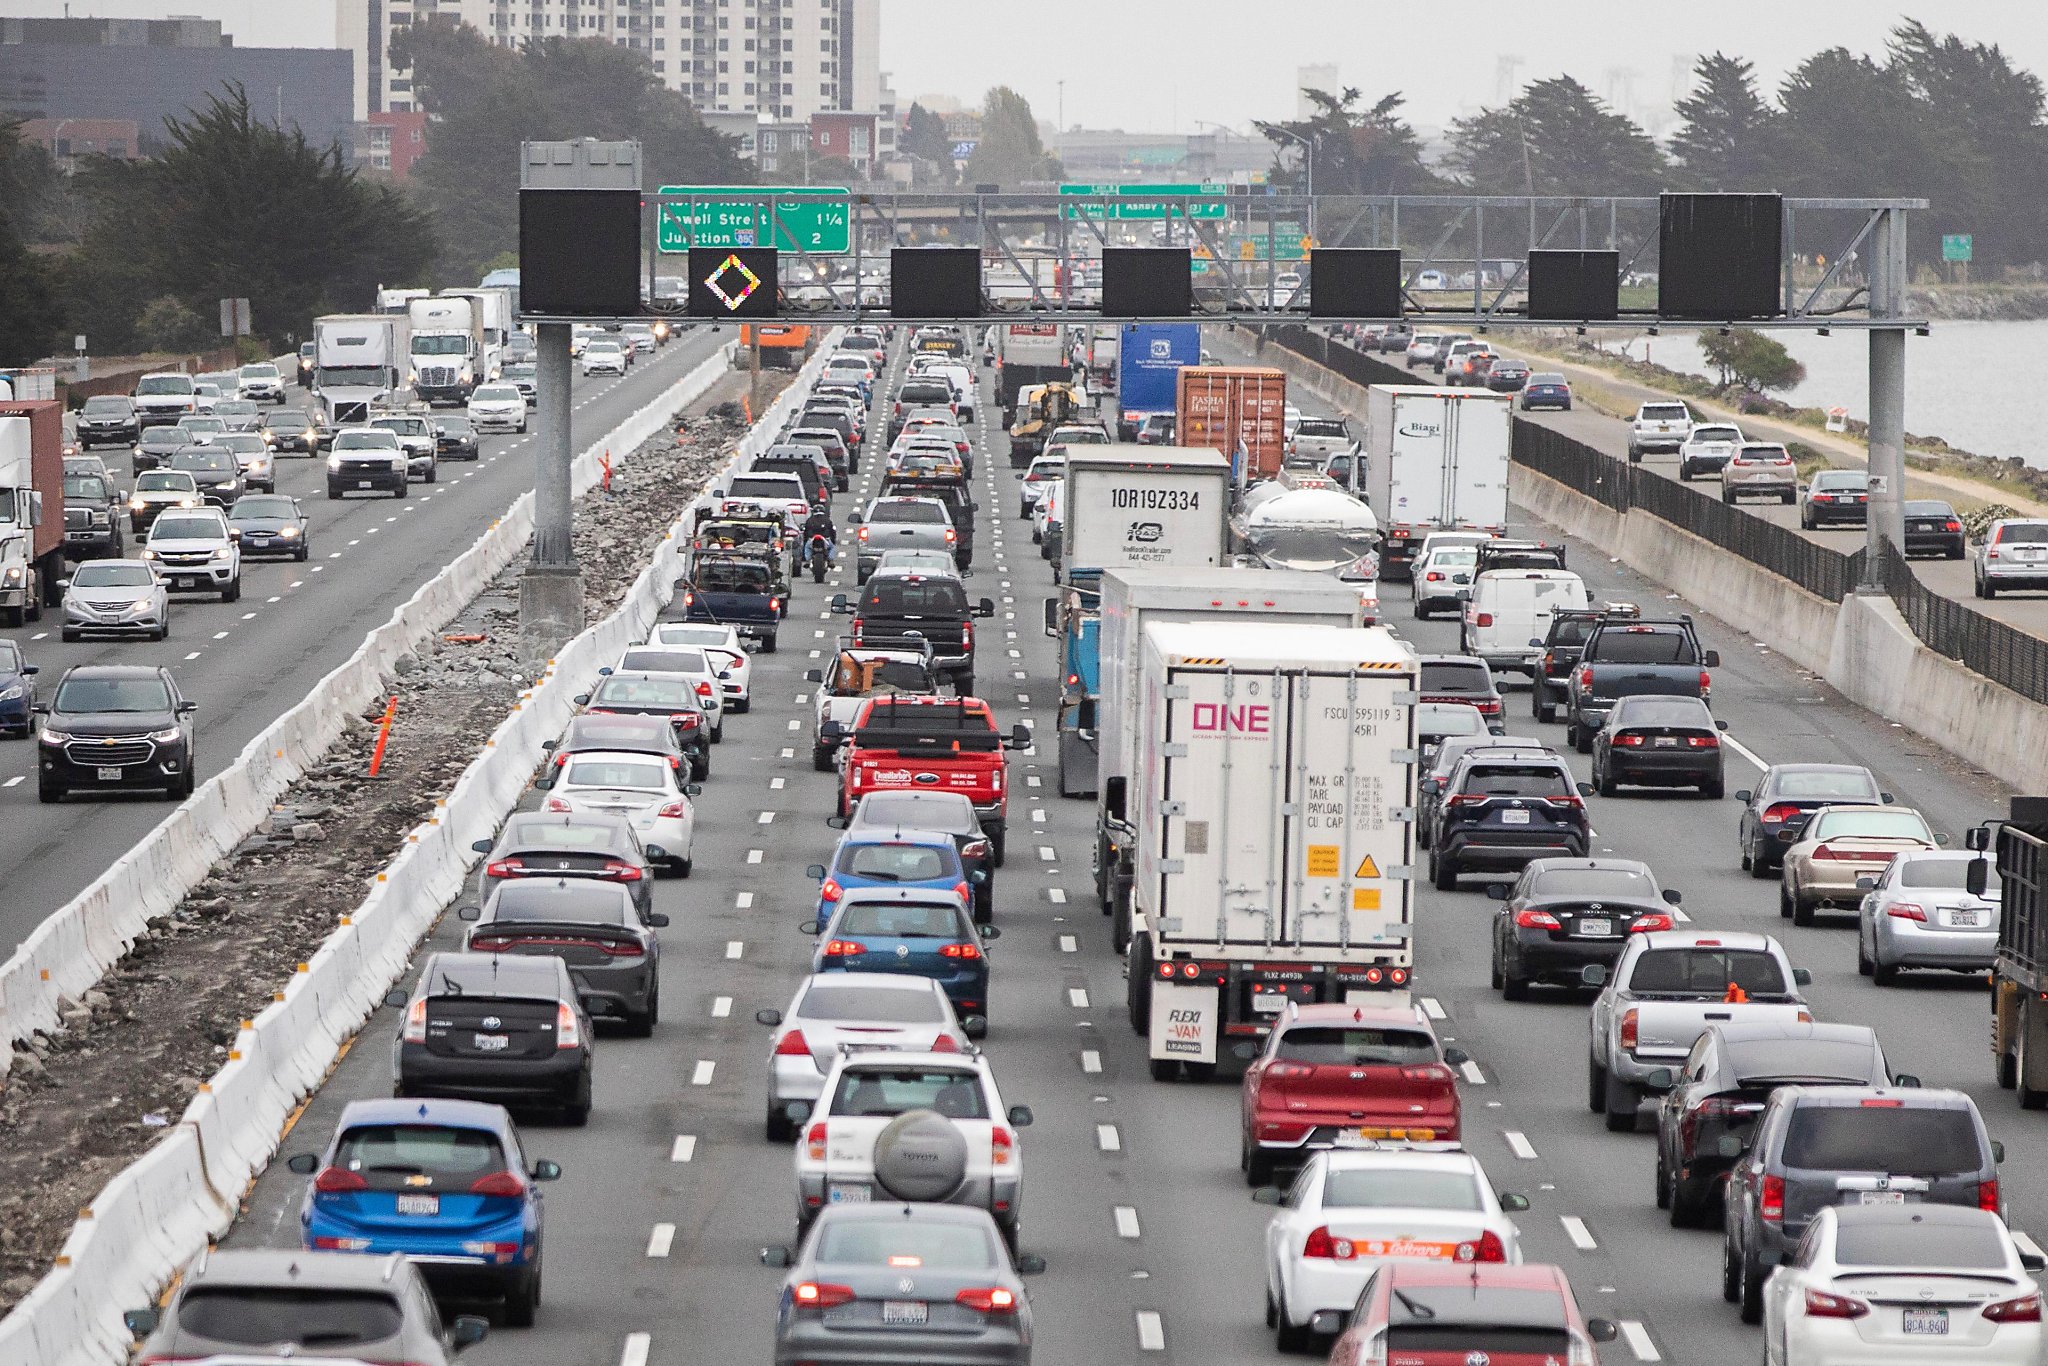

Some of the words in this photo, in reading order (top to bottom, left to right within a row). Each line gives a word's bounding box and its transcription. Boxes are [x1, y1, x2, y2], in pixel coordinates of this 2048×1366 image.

[719, 213, 767, 225] Stret
[812, 233, 821, 244] 2
[925, 342, 956, 350] STANLEY
[1153, 344, 1167, 354] RA
[1192, 395, 1224, 405] PASHA
[1411, 422, 1440, 436] Biagi
[1112, 488, 1200, 510] 10R19Z334
[1193, 702, 1270, 733] ONE
[1325, 707, 1348, 720] FSCU
[1355, 708, 1390, 720] 595119
[1395, 708, 1401, 721] 3
[1354, 724, 1377, 736] 45R1
[1309, 775, 1327, 787] MAX
[1334, 775, 1345, 787] GR
[1309, 788, 1329, 801] TARE
[1308, 802, 1344, 815] PAYLOAD
[1326, 816, 1344, 828] CAP
[1169, 1009, 1202, 1023] FLEXI
[1167, 1043, 1201, 1052] LEASING
[902, 1151, 940, 1161] TOYOTA
[1906, 1320, 1946, 1334] 8CAL860
